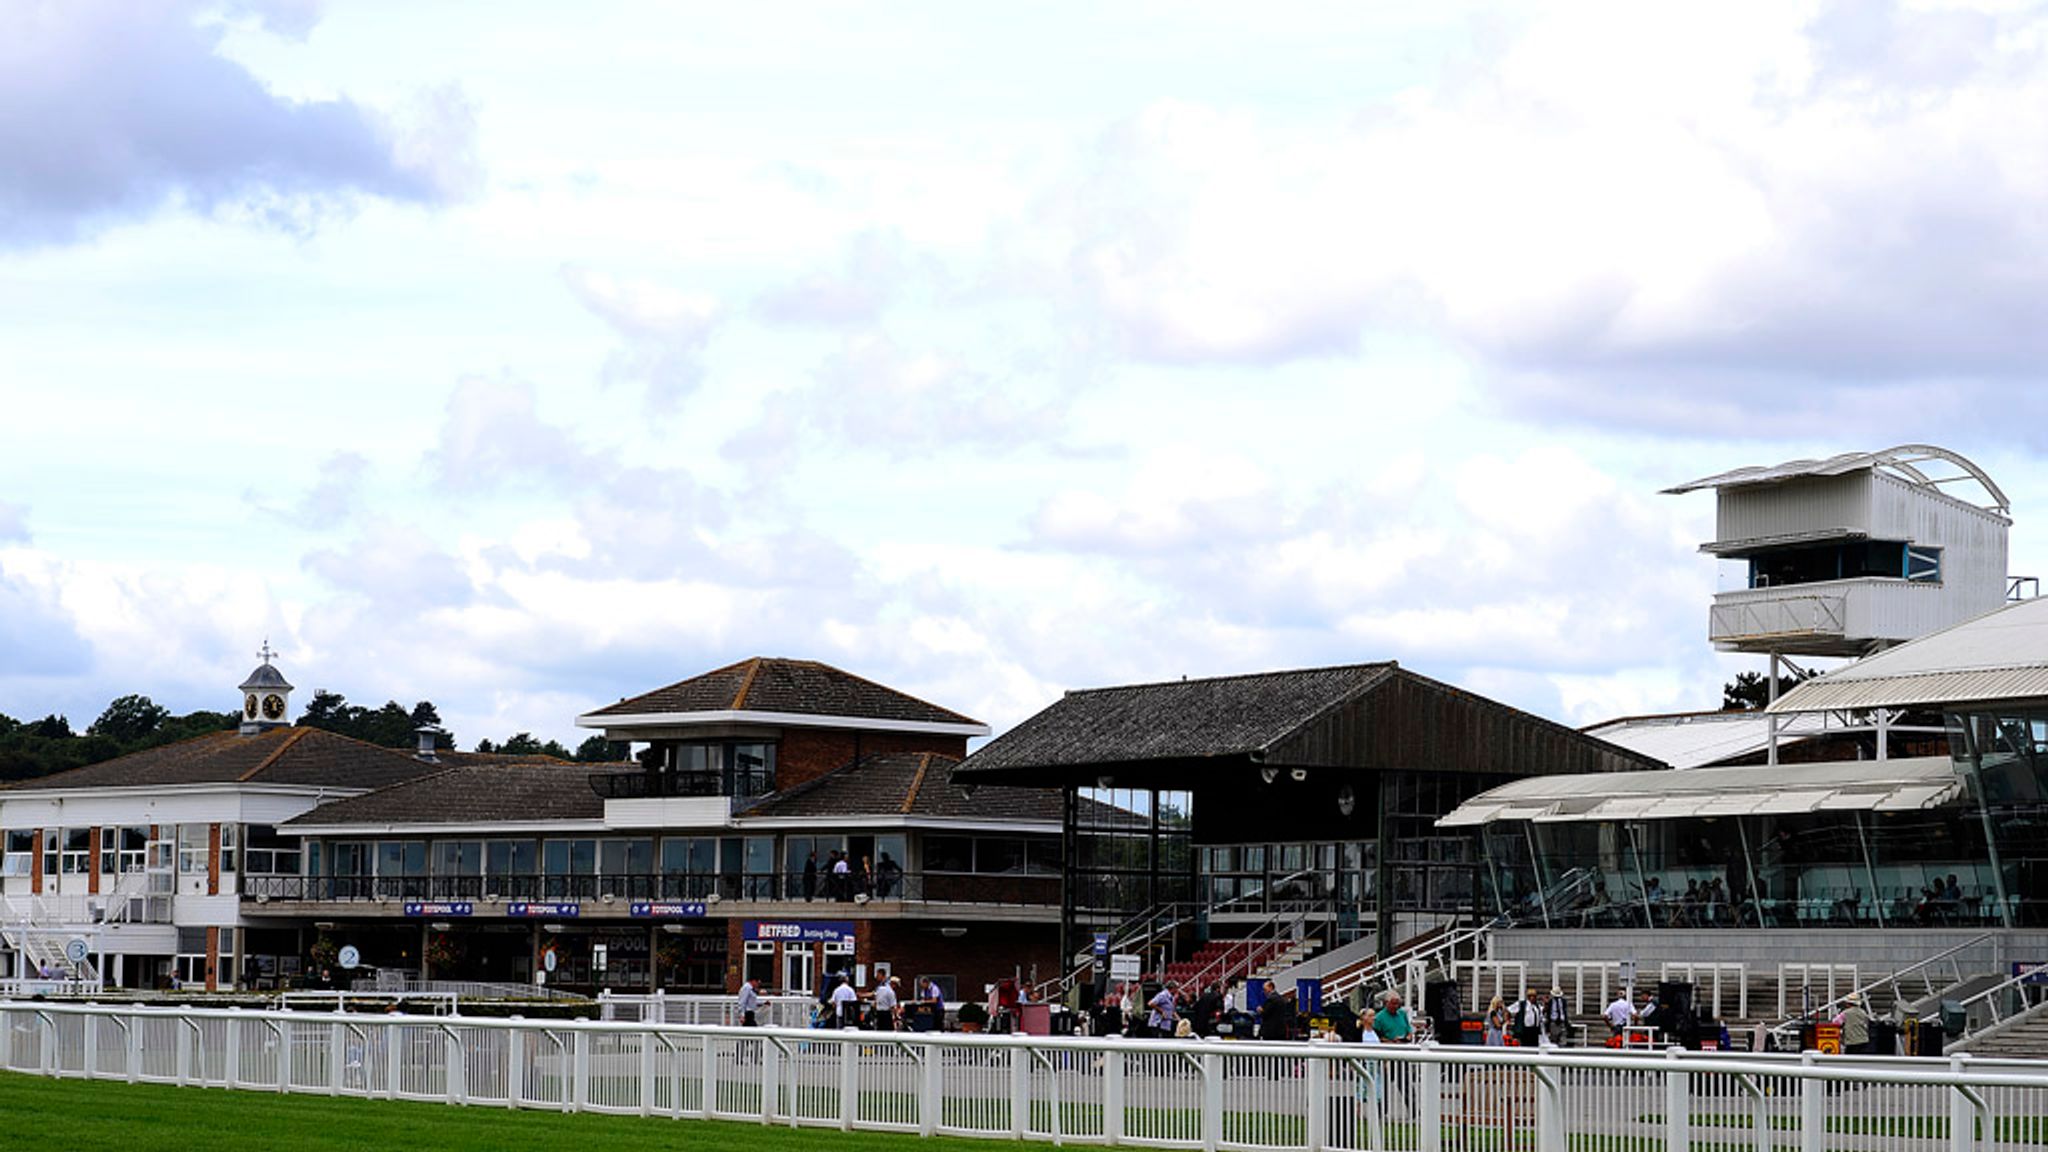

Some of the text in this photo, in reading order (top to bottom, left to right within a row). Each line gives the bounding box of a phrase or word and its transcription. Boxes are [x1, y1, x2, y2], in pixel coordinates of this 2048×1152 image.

[651, 904, 684, 914] TOTEPOOL
[757, 923, 801, 938] BETFRED
[71, 944, 85, 959] 3
[343, 950, 356, 965] 2
